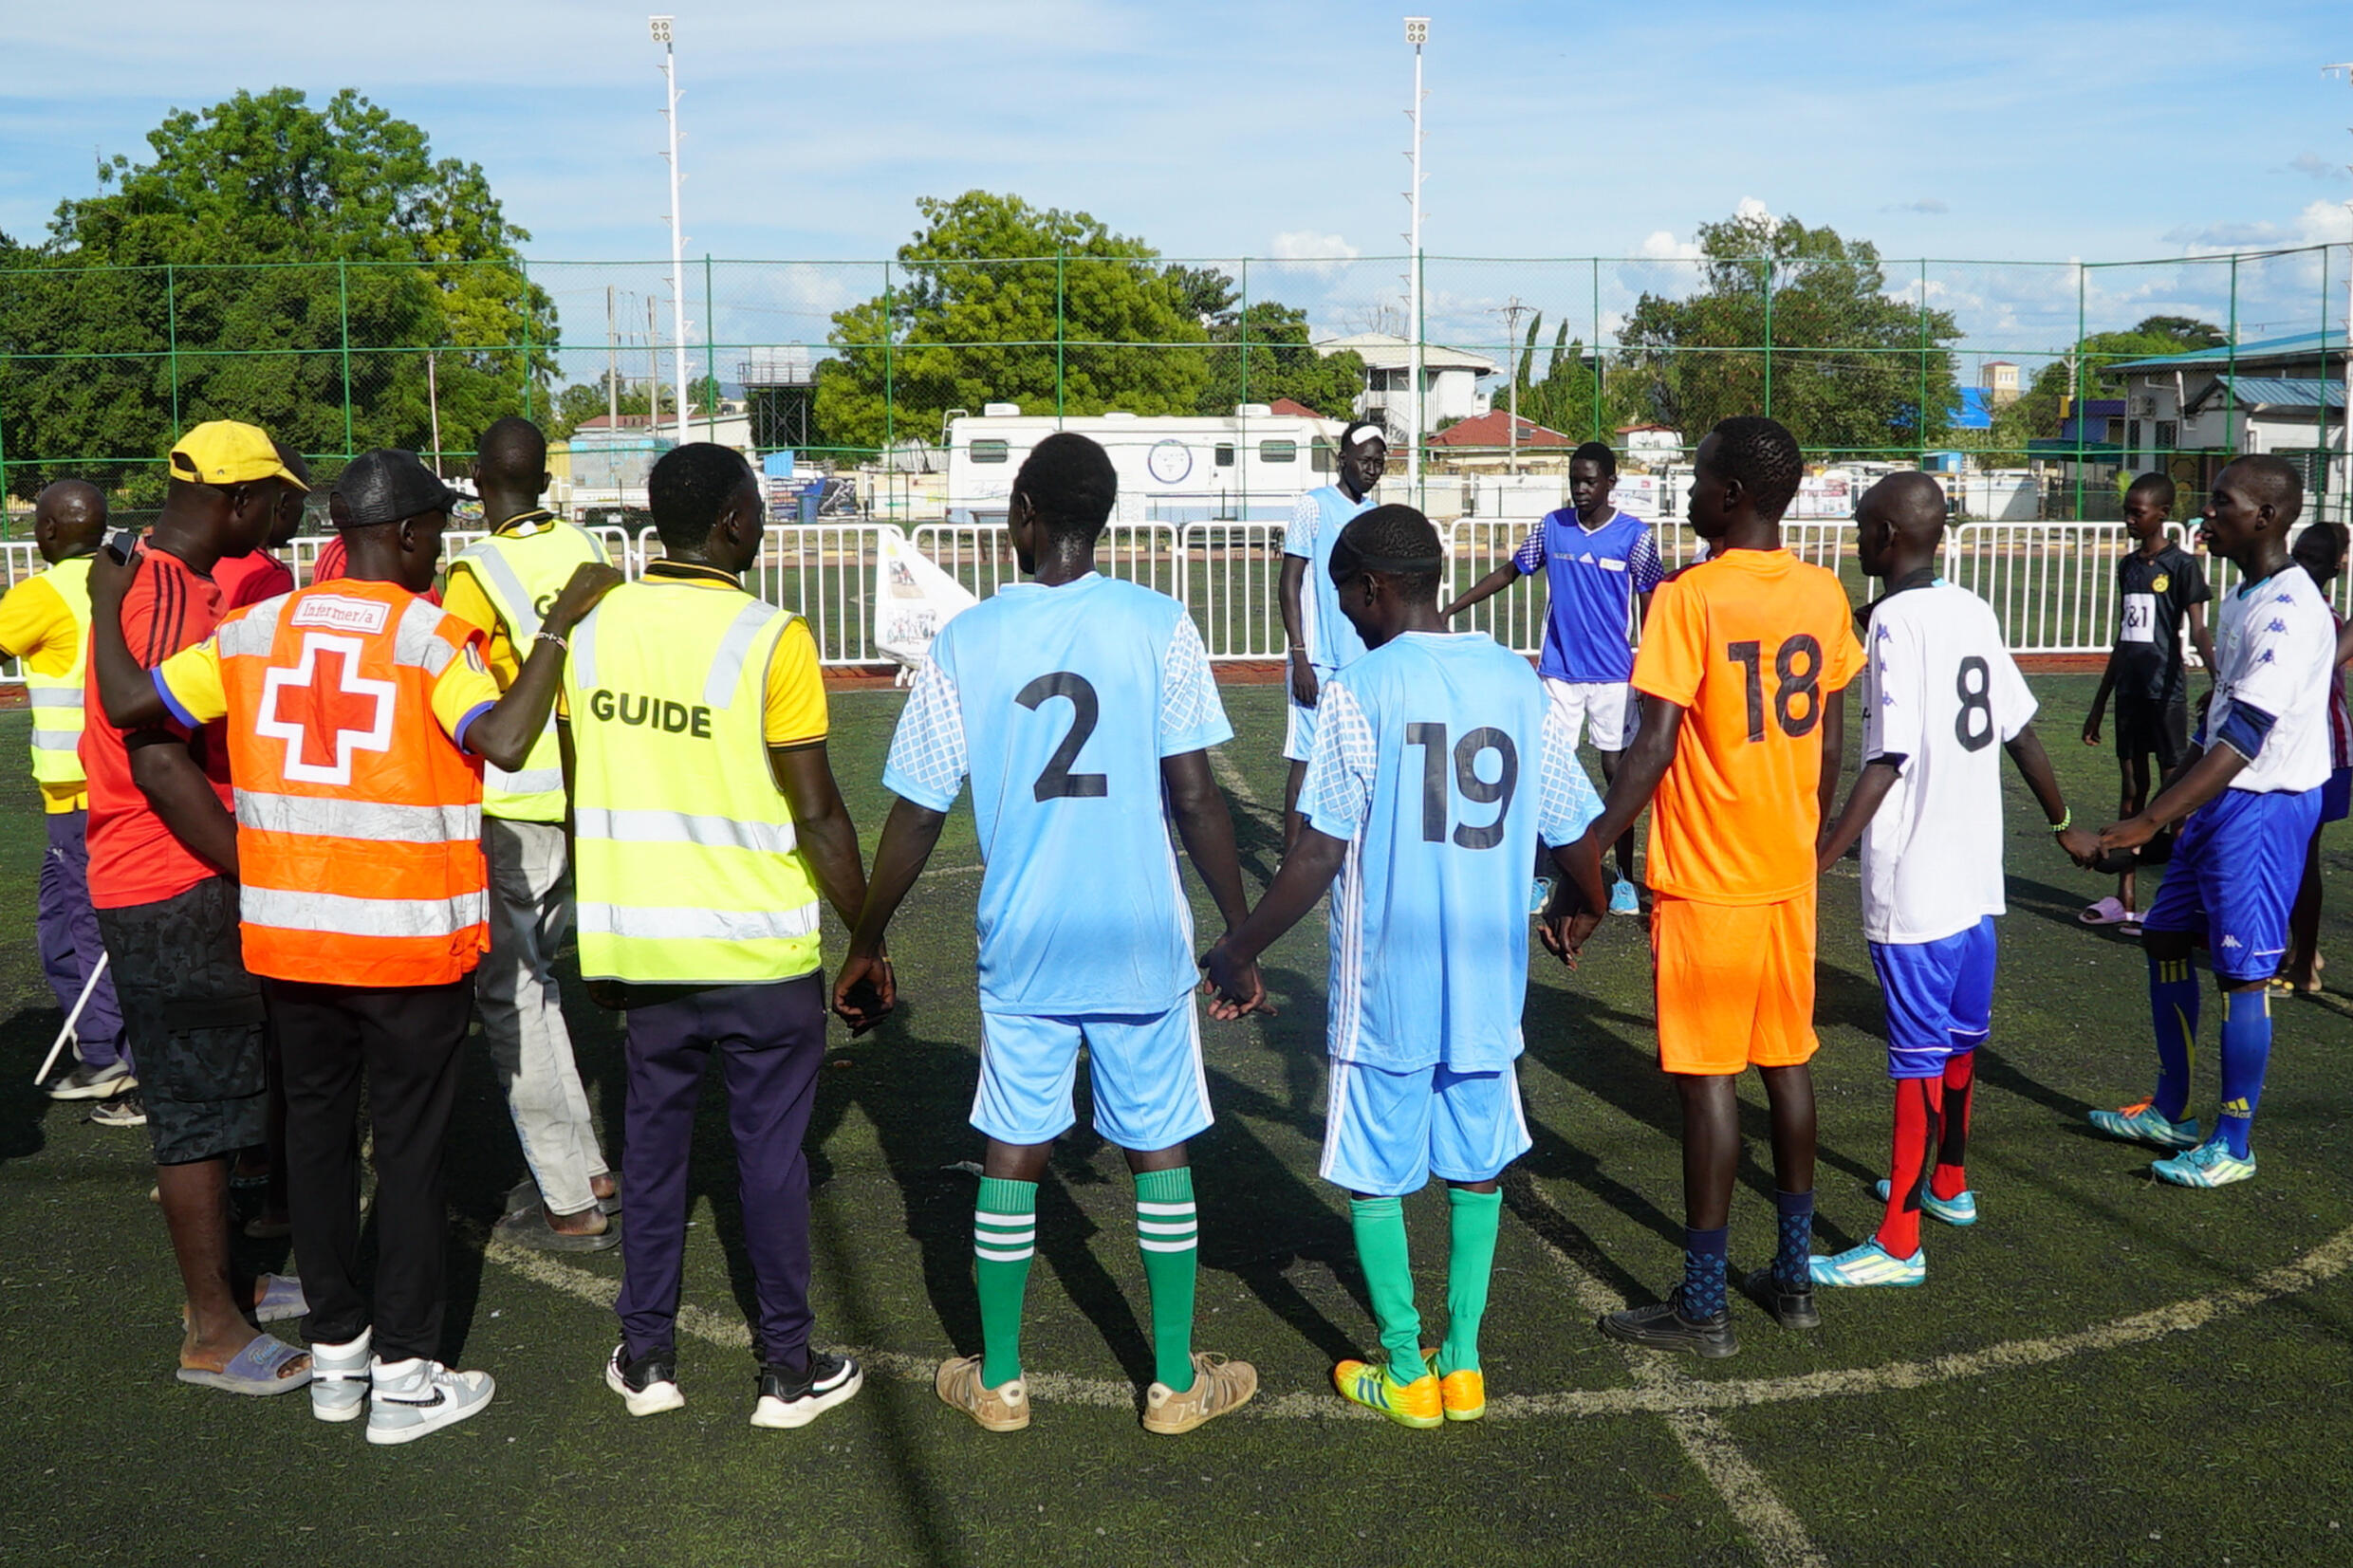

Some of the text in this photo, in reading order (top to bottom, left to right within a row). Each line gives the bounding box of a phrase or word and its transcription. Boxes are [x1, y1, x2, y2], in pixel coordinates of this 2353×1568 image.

[303, 602, 374, 624] Infermer/a
[590, 689, 712, 740] GUIDE
[1014, 671, 1108, 803] 2
[1727, 633, 1823, 743] 18
[1955, 655, 1994, 753] 8
[1406, 722, 1519, 850] 19
